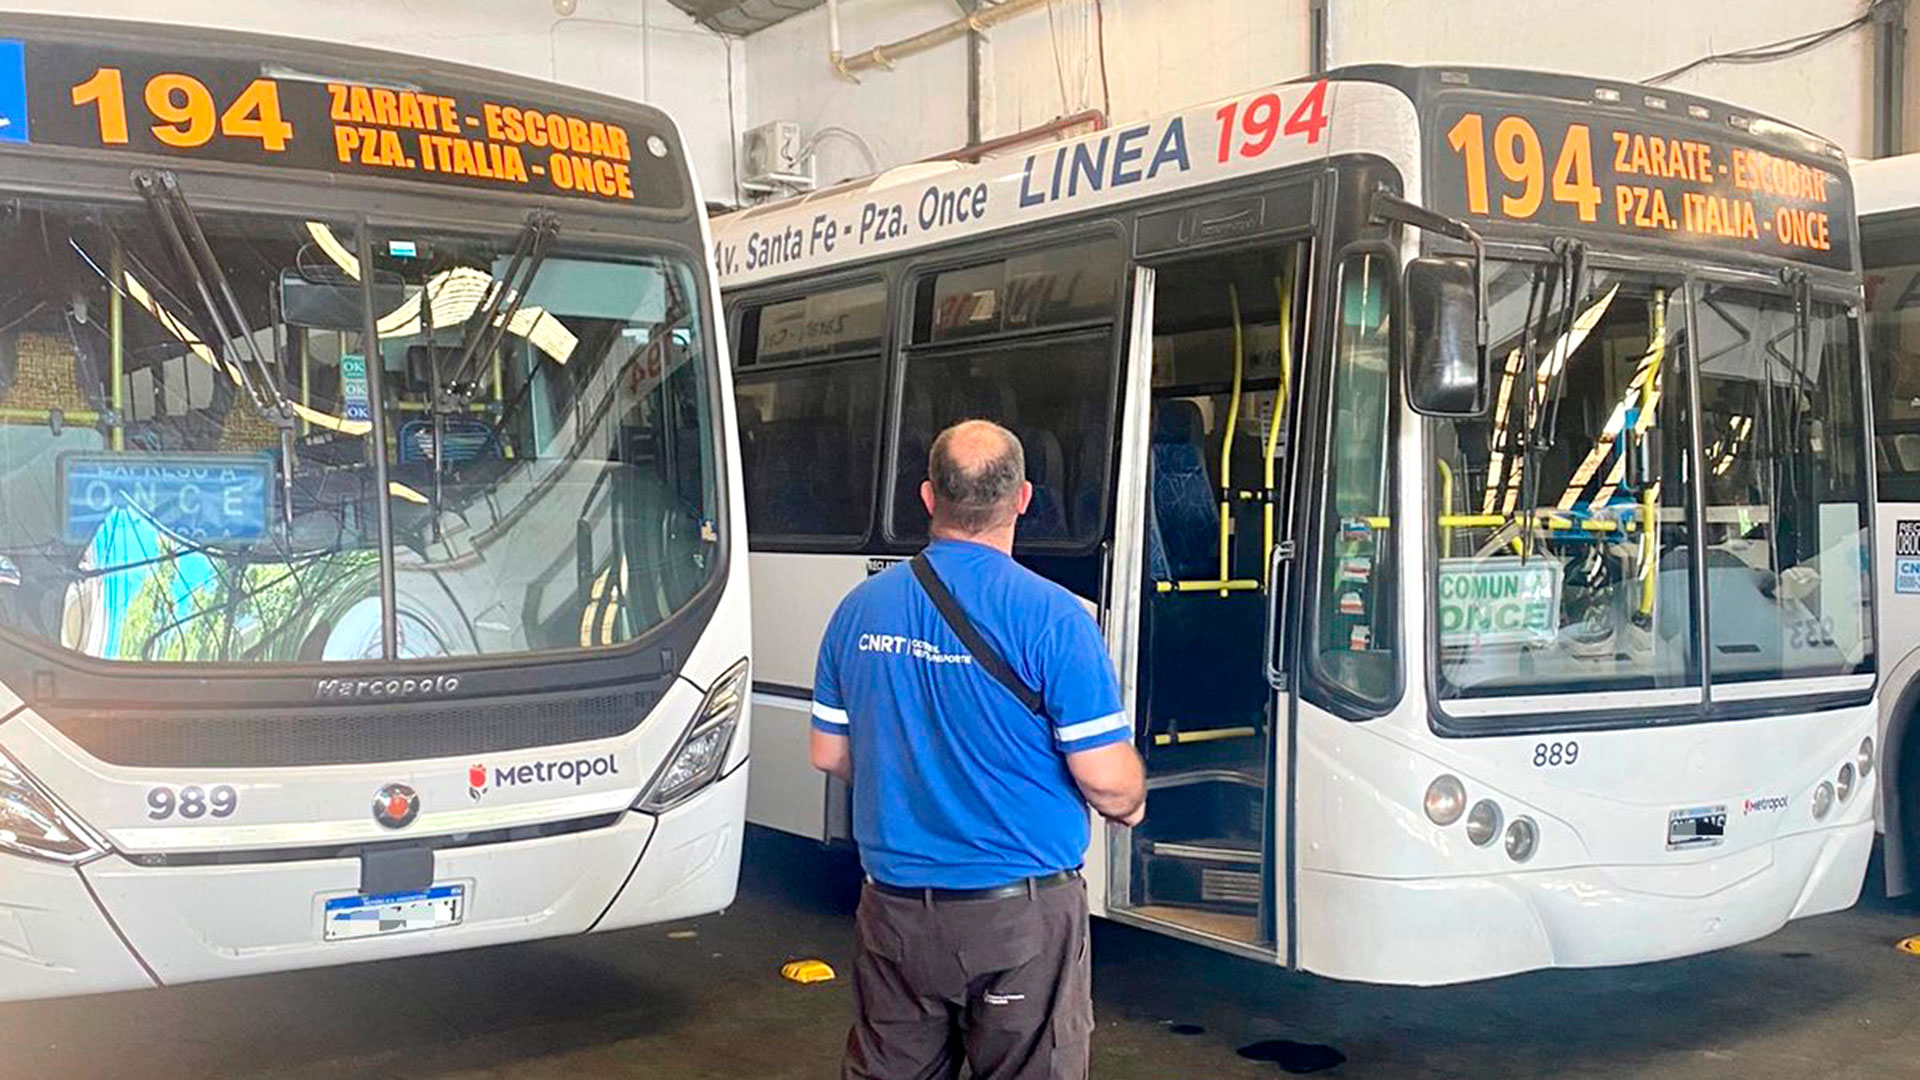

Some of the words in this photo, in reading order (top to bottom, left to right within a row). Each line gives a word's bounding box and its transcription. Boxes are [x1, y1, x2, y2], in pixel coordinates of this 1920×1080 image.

[71, 67, 294, 152] 194
[327, 83, 462, 134] ZARATE
[465, 115, 480, 127] -
[483, 103, 631, 161] ESCOBAR
[333, 124, 416, 169] PZA.
[418, 133, 529, 183] ITALIA
[531, 164, 545, 176] -
[549, 152, 635, 199] ONCE
[1019, 116, 1191, 209] LINEA
[1215, 79, 1329, 164] 194
[1447, 112, 1602, 223] 194
[1612, 131, 1714, 184] ZARATE
[1718, 163, 1728, 175] -
[1732, 148, 1828, 203] ESCOBAR
[746, 224, 803, 271] Santa
[810, 214, 837, 256] Fe
[844, 224, 852, 235] -
[859, 202, 908, 245] Pza.
[918, 183, 988, 231] Once
[1615, 185, 1678, 231] PZA.
[1682, 191, 1759, 240] ITALIA
[1763, 220, 1772, 231] -
[1775, 210, 1831, 251] ONCE
[343, 360, 364, 373] OK
[345, 383, 366, 397] OK
[347, 406, 370, 419] OK
[85, 480, 245, 517] ONCE
[1440, 575, 1519, 600] COMUN
[1440, 602, 1547, 633] ONCE
[858, 633, 907, 655] CNRT
[315, 675, 459, 699] Marcopolo
[494, 754, 619, 788] Metropol
[1533, 740, 1579, 768] 889
[147, 785, 238, 821] 989
